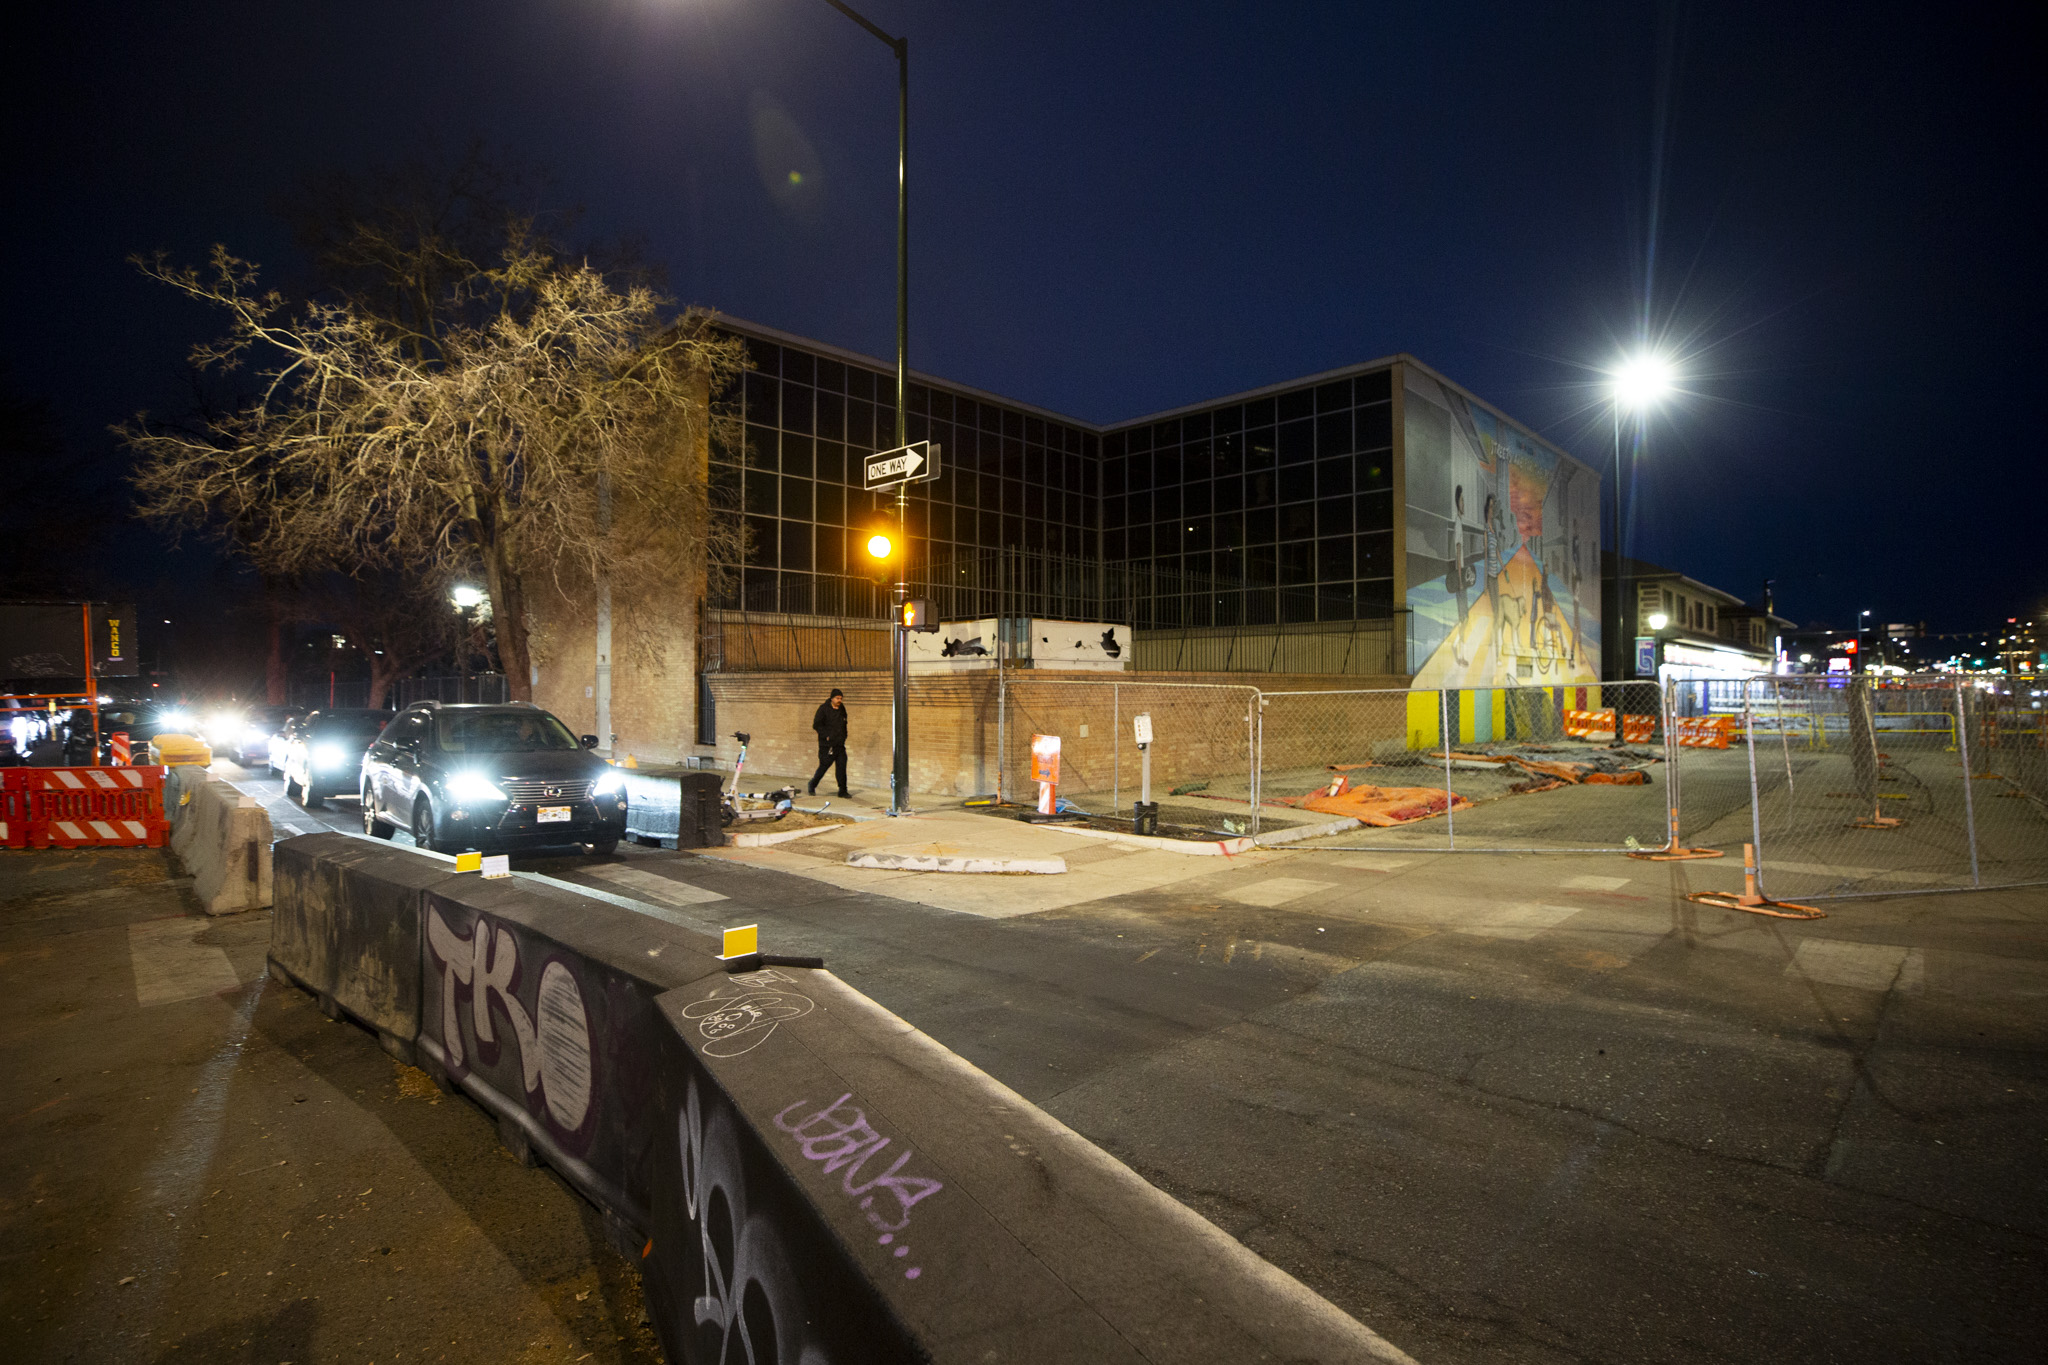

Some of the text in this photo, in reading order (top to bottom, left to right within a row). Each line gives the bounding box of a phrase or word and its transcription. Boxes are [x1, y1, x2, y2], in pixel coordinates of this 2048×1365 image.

[870, 456, 908, 478] ONE WAY
[107, 619, 120, 657] WANCO
